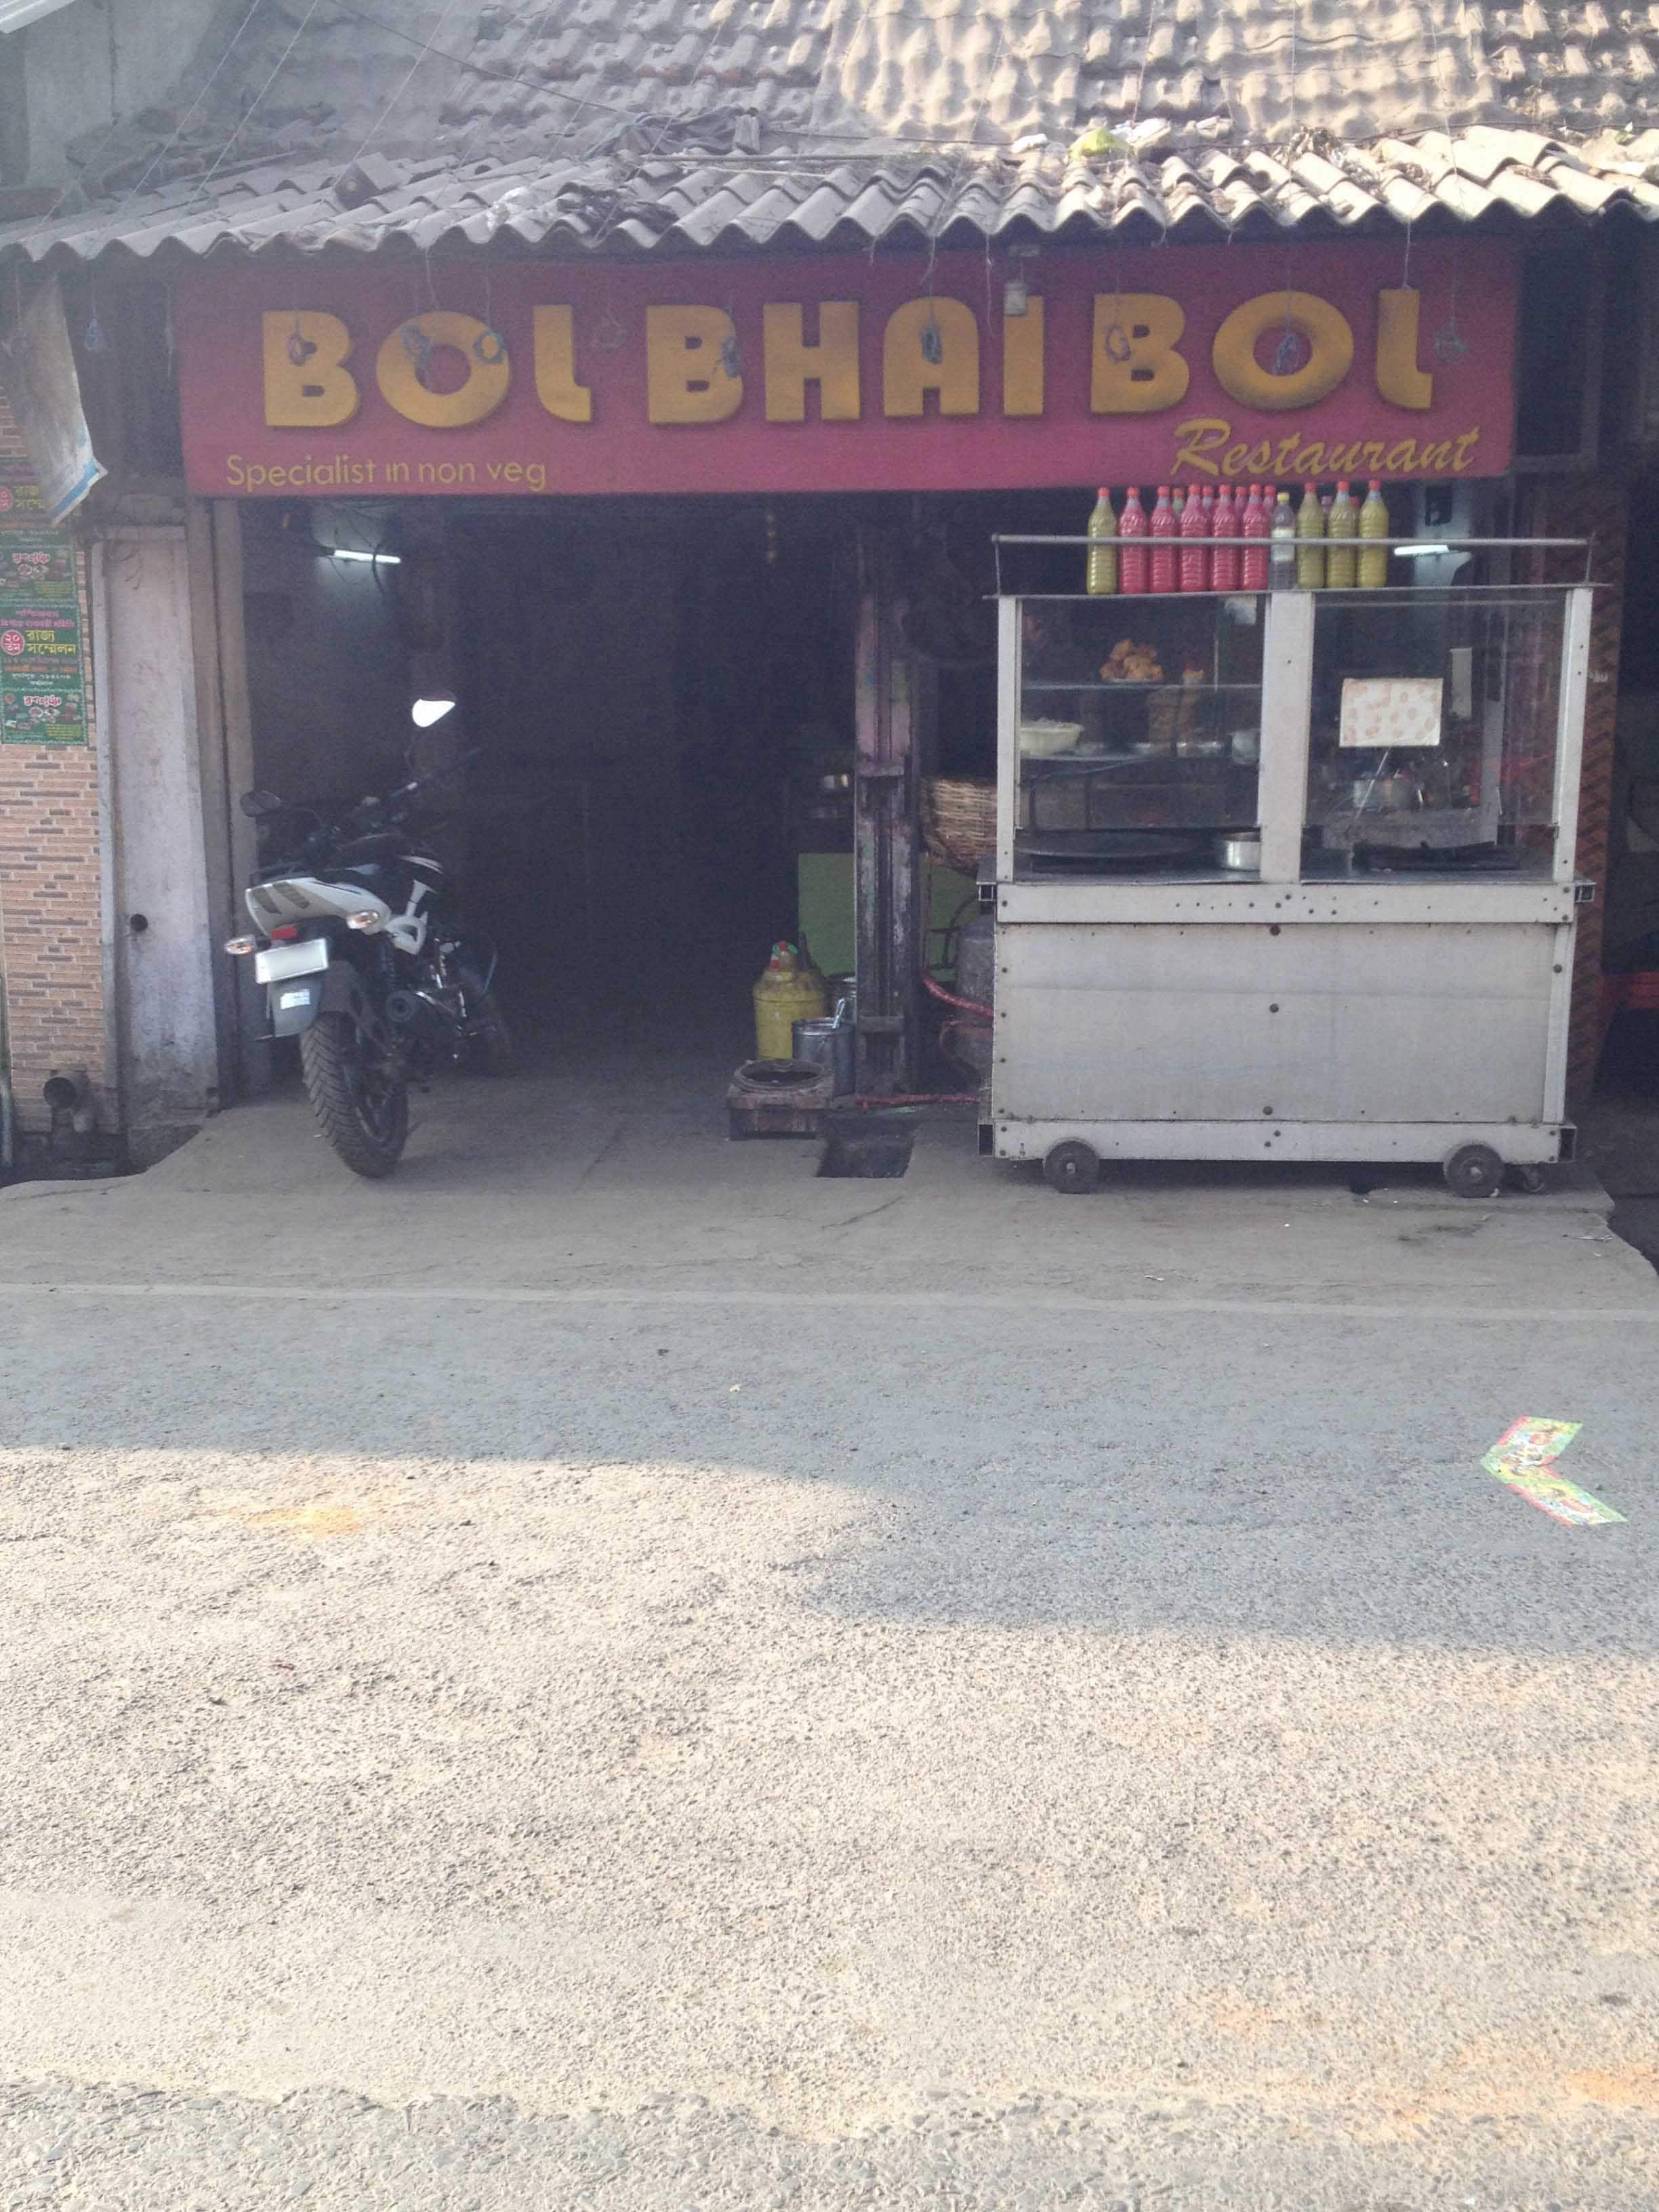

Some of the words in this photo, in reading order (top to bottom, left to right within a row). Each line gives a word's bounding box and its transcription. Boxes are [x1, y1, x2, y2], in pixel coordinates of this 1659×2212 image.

[263, 304, 592, 428] BOL
[647, 296, 1044, 424] BHAI
[1090, 289, 1433, 415] BOL
[1171, 417, 1480, 476] Restaurant
[226, 454, 375, 493] Specialist
[386, 462, 410, 484] in
[418, 462, 474, 484] non
[487, 461, 546, 493] veg
[25, 630, 55, 643] রাজ্য
[26, 643, 76, 656] সম্মেলন
